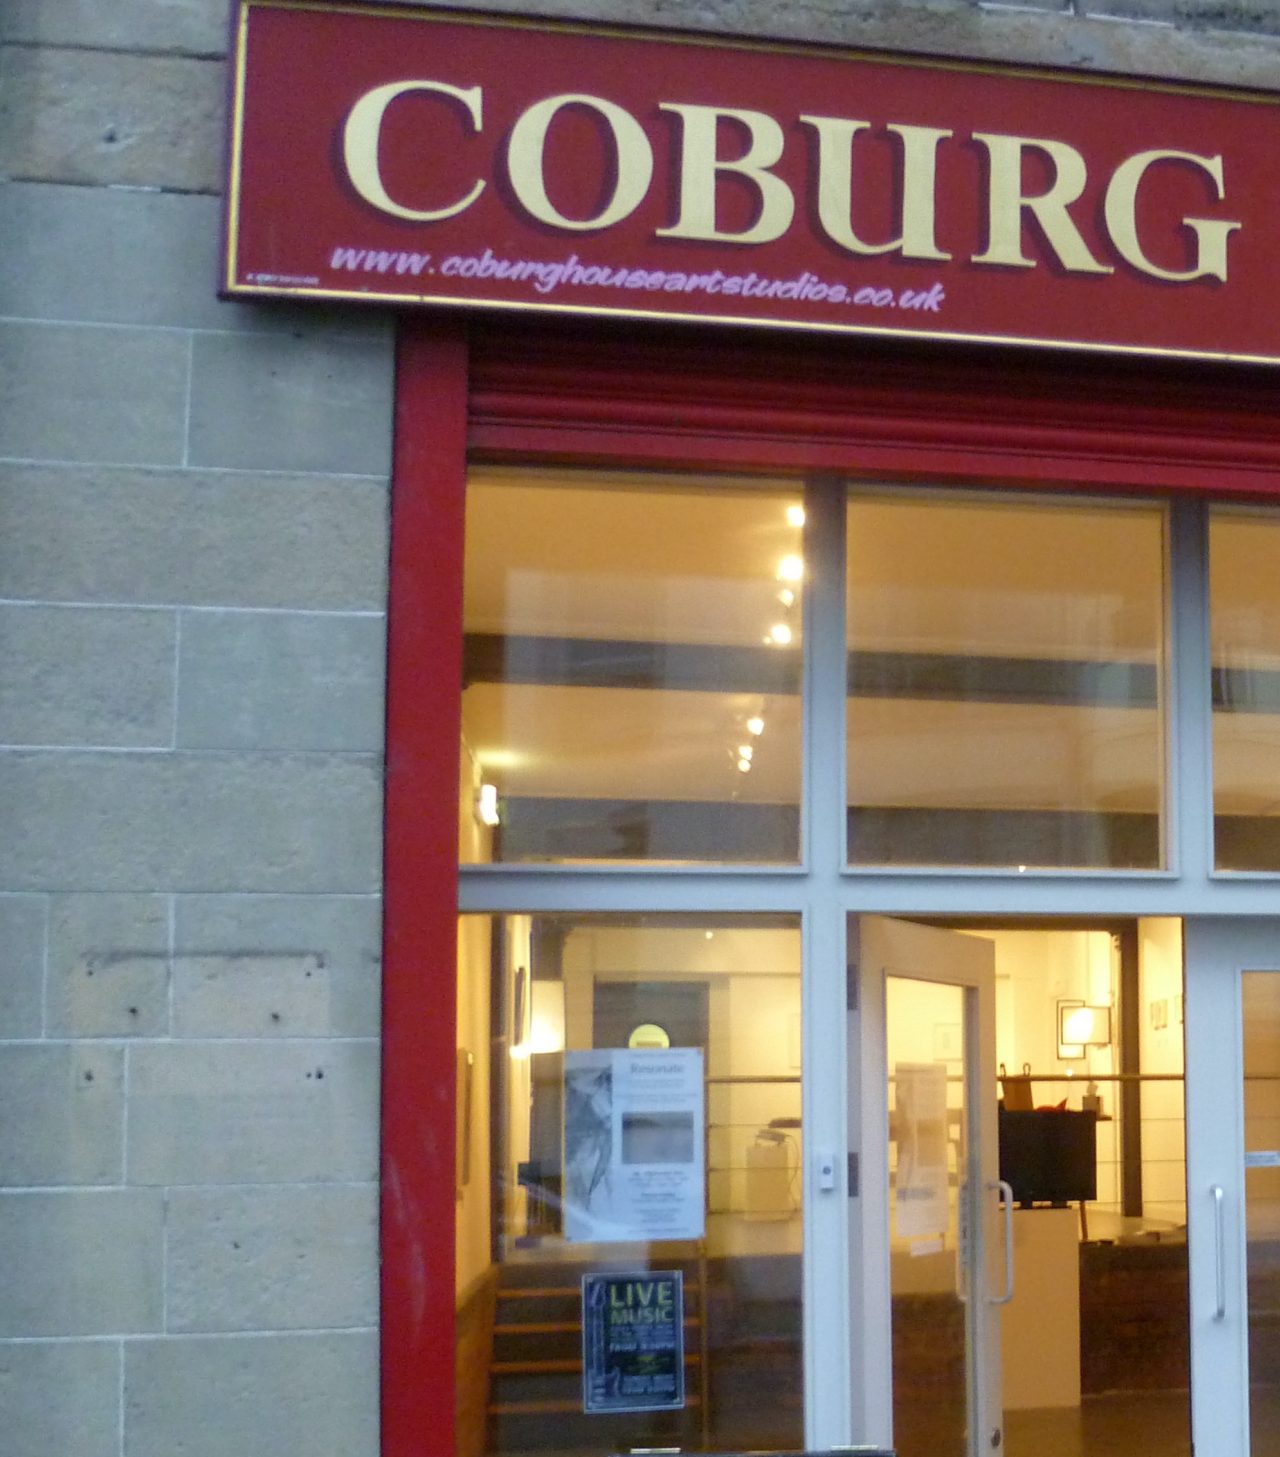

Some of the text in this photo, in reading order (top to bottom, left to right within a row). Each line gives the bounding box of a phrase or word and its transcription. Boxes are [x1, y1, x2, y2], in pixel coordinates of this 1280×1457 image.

[342, 80, 1242, 283] COBURG
[610, 1282, 674, 1307] LIVE
[610, 1305, 674, 1325] MUSIC
